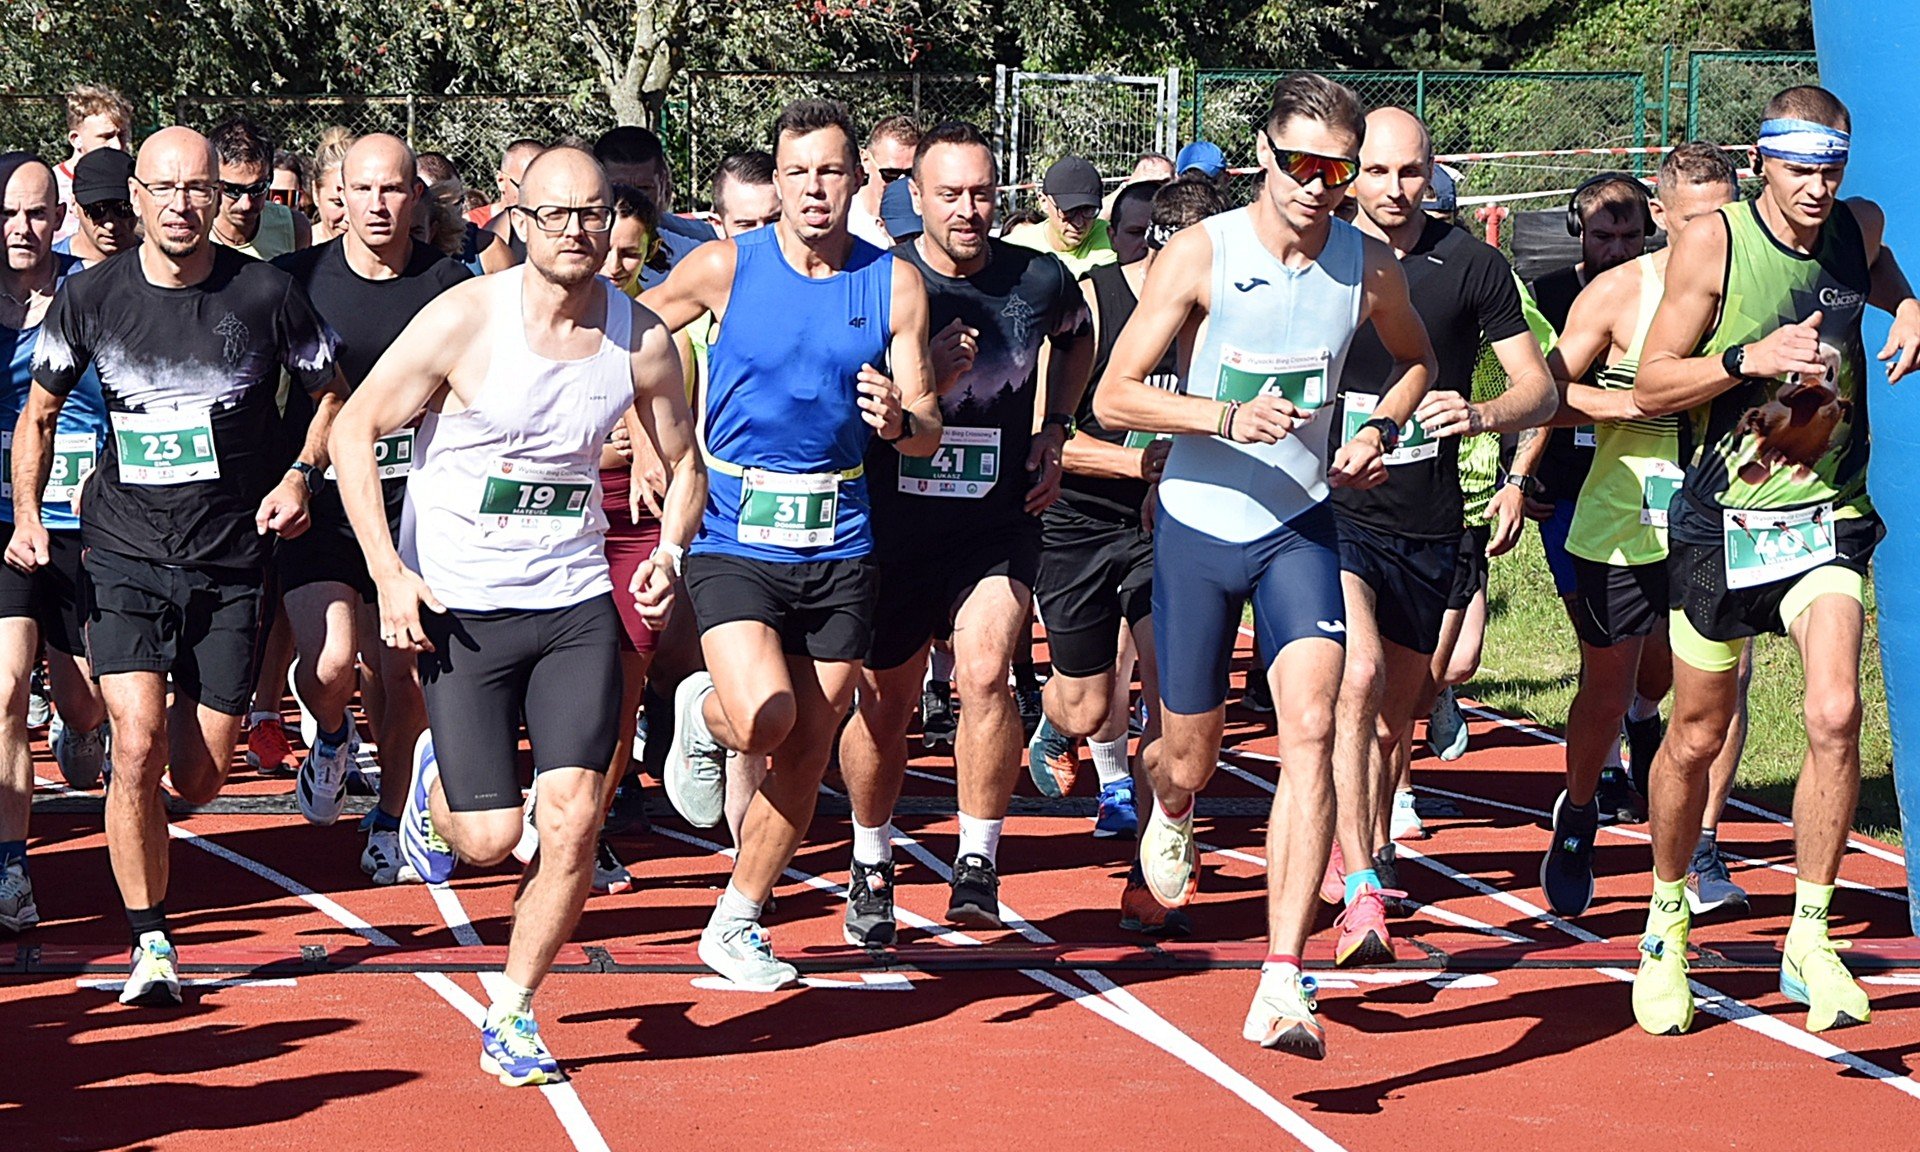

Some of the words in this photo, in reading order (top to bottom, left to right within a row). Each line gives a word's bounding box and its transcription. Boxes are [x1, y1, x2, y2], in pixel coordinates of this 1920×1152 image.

[1258, 376, 1283, 398] 4
[140, 433, 182, 461] 23
[373, 441, 389, 462] 0
[931, 447, 965, 473] 41
[49, 454, 69, 480] 8
[518, 484, 556, 509] 19
[774, 495, 808, 523] 31
[512, 508, 550, 516] MATEUSZ
[1754, 528, 1804, 558] 40
